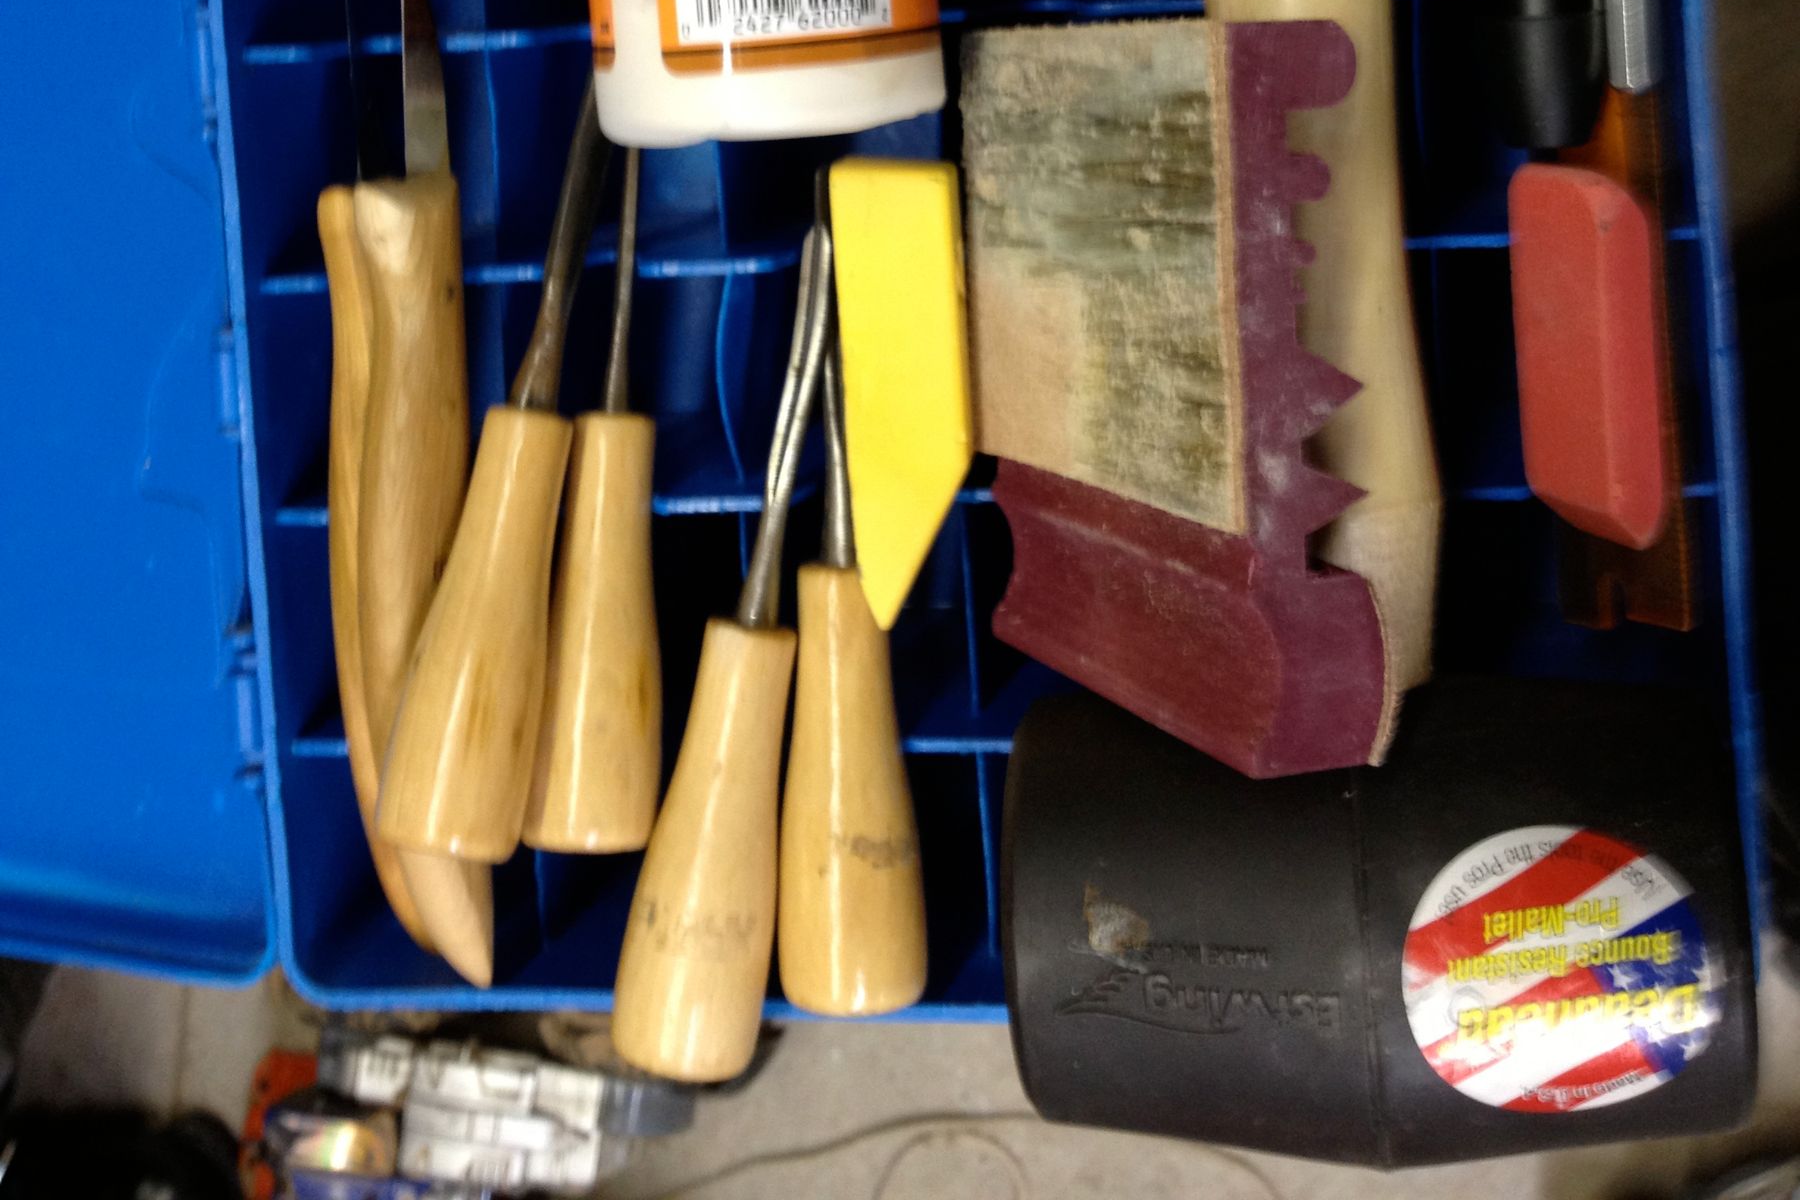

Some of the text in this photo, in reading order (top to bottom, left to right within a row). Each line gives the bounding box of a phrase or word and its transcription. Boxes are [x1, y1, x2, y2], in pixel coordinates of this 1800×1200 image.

[1463, 855, 1504, 889] Pros
[1503, 844, 1534, 866] the
[1483, 896, 1620, 944] Pro-Mallet
[1447, 930, 1675, 983] Bounce Resistant
[1144, 972, 1340, 1028] Estwing
